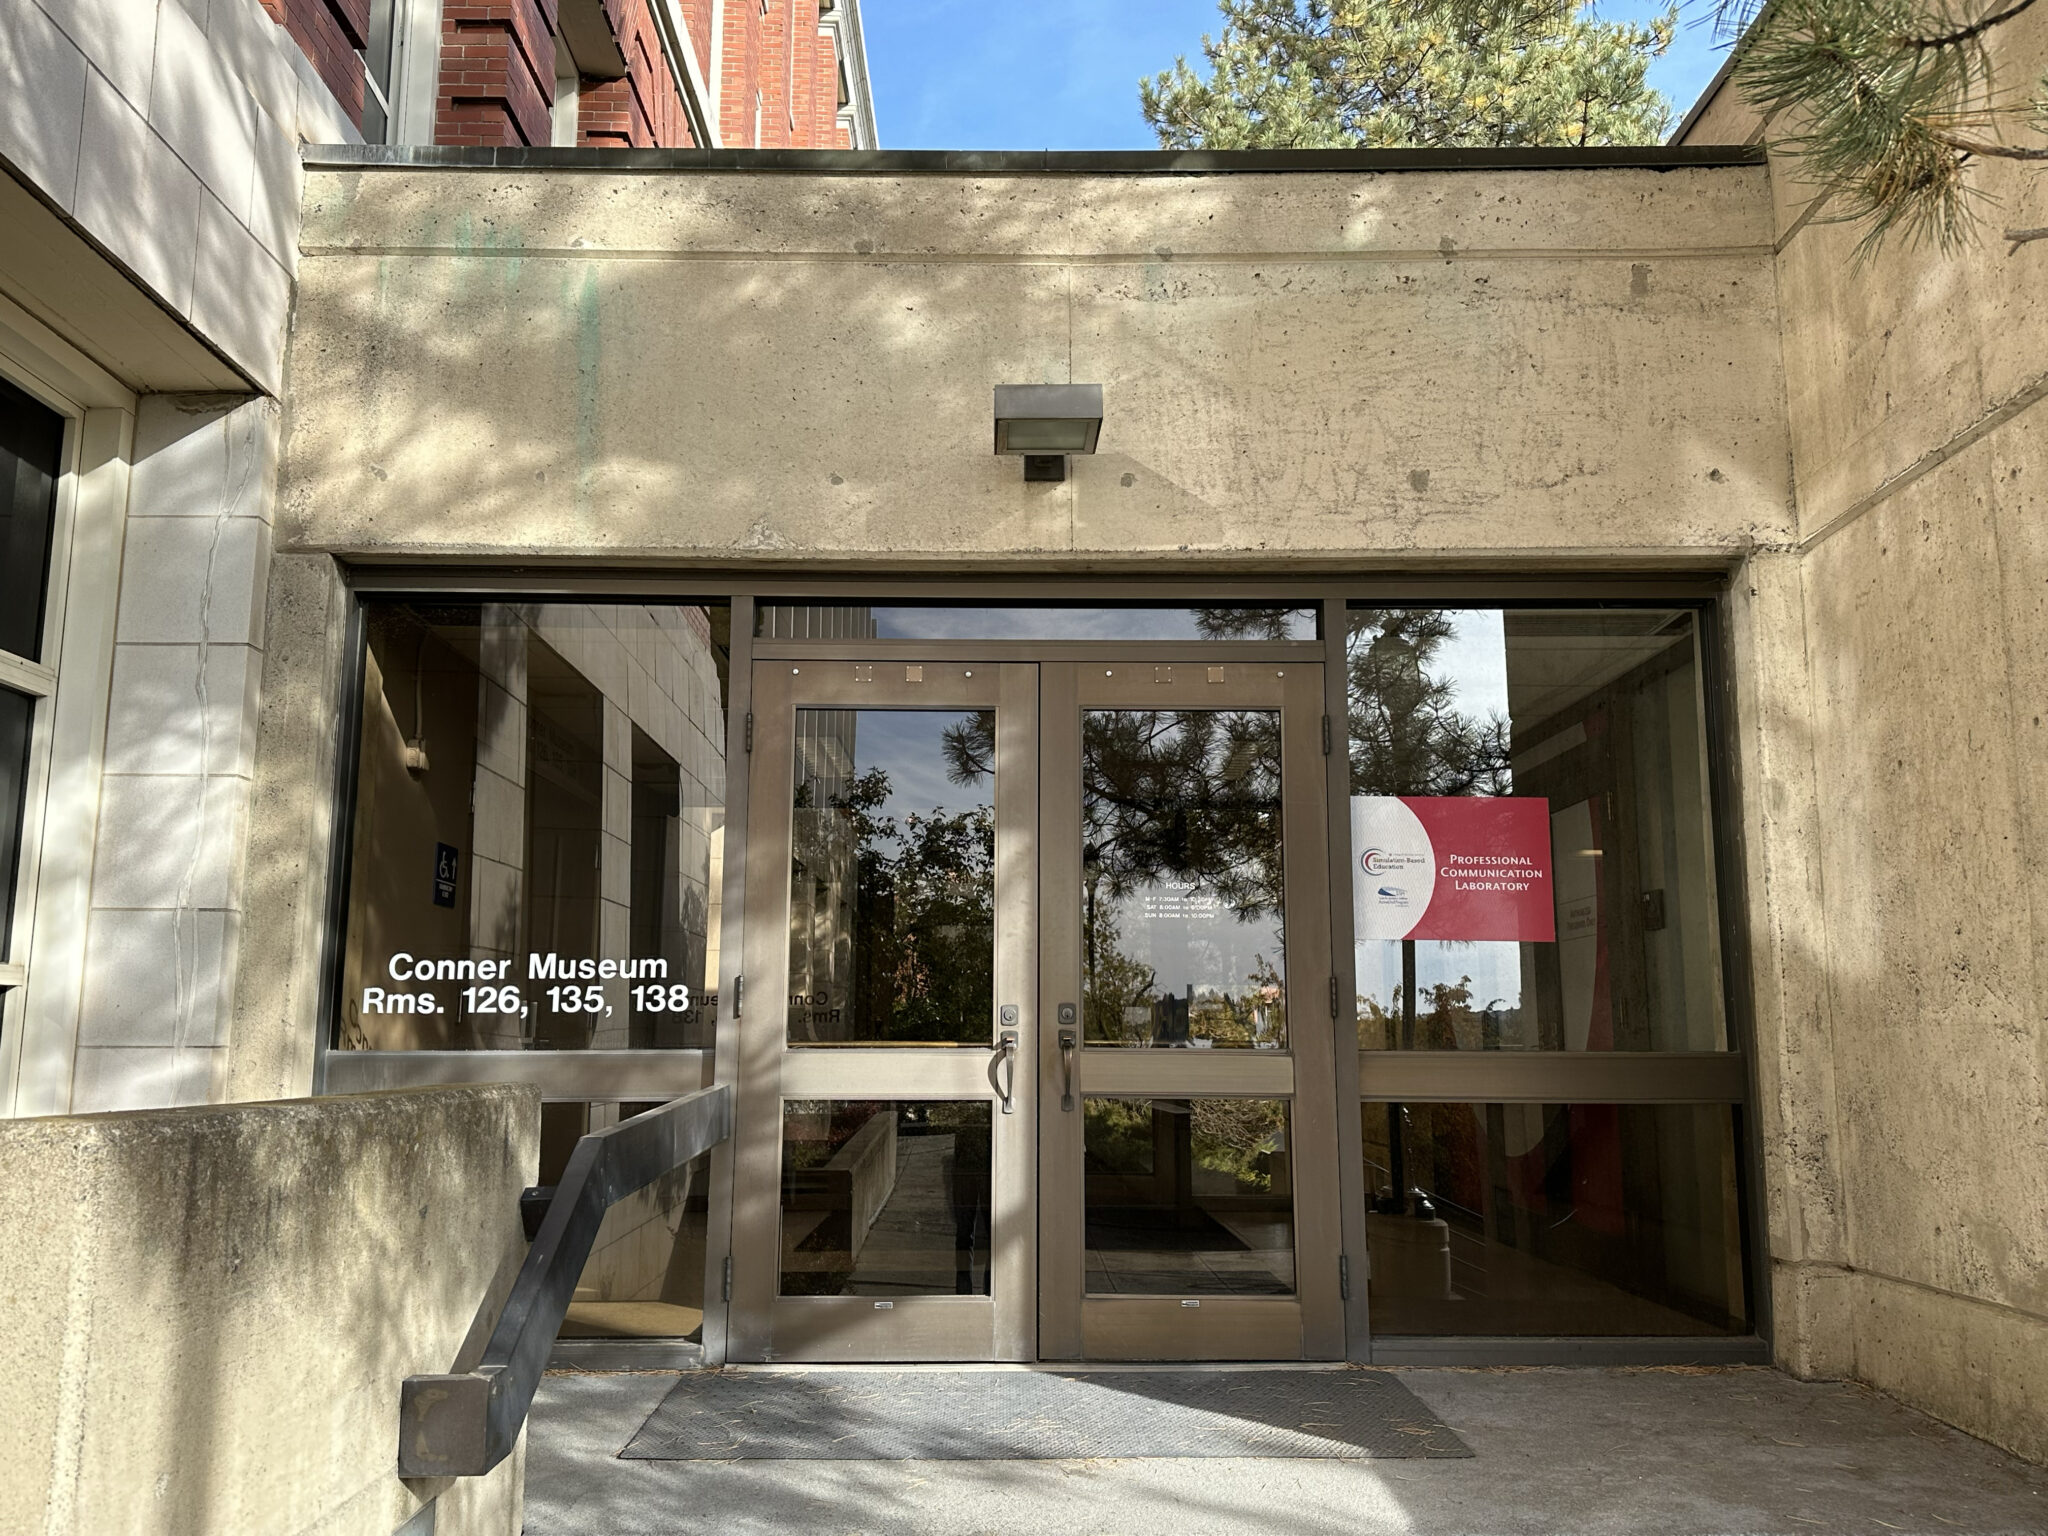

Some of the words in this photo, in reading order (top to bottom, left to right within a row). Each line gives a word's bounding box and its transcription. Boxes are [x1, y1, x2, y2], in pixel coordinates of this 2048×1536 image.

[1450, 854, 1533, 865] PROFESSIONAL
[1440, 867, 1543, 878] COMMUNICATION
[1165, 882, 1196, 890] HOURS
[1455, 880, 1530, 891] LABORATORY
[388, 952, 512, 981] Conner
[528, 953, 668, 980] Museum
[362, 987, 445, 1014] Rms.
[461, 985, 530, 1020] 126,
[545, 984, 614, 1018] 135,
[630, 984, 690, 1013] 138
